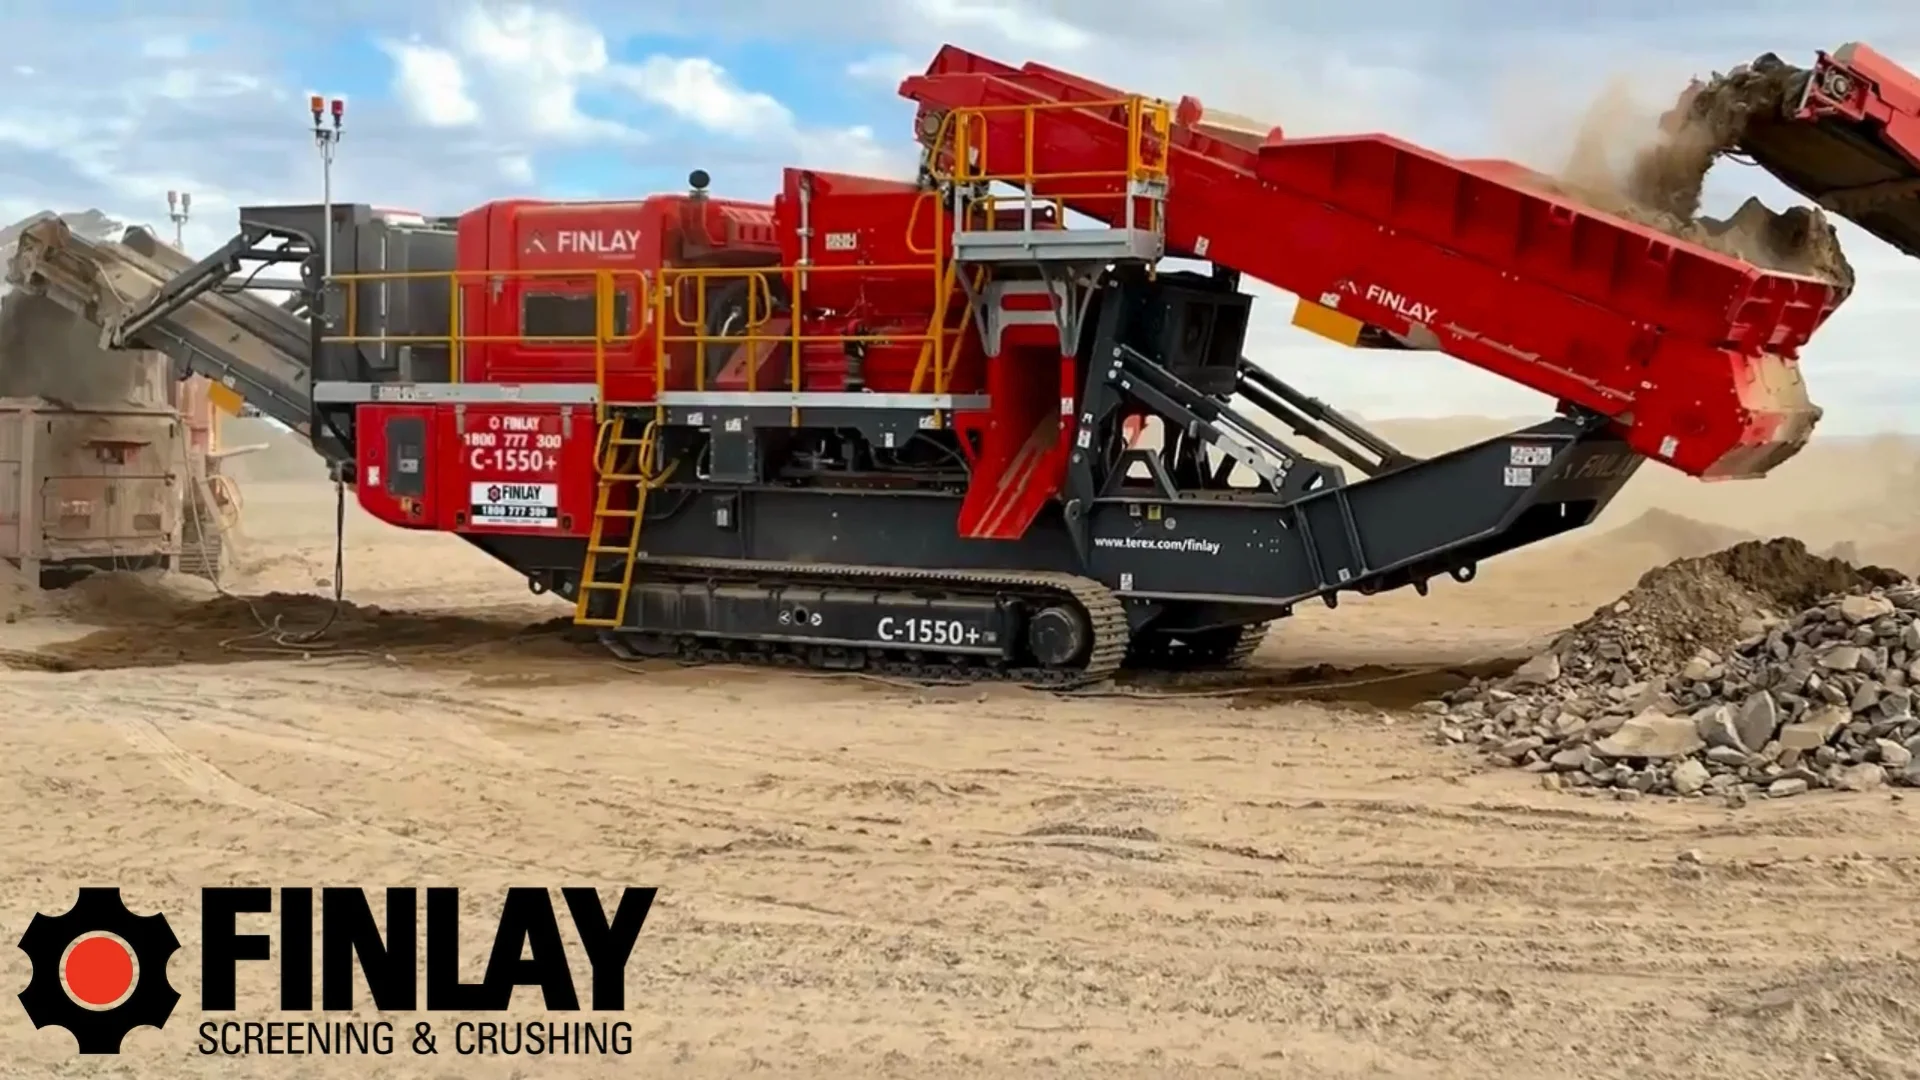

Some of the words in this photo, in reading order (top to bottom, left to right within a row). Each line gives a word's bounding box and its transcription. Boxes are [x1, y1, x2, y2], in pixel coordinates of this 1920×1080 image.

[557, 230, 642, 253] FINLAY
[1365, 284, 1438, 323] FINLAY
[503, 416, 540, 431] FINLAY
[463, 432, 496, 447] 1800
[503, 433, 529, 447] 777
[536, 434, 562, 448] 300
[470, 448, 557, 472] C-1550+
[502, 485, 541, 500] FINLAY
[508, 506, 526, 517] 777
[1094, 537, 1220, 555] www.terex.com/finlay
[878, 617, 980, 645] C-1550+
